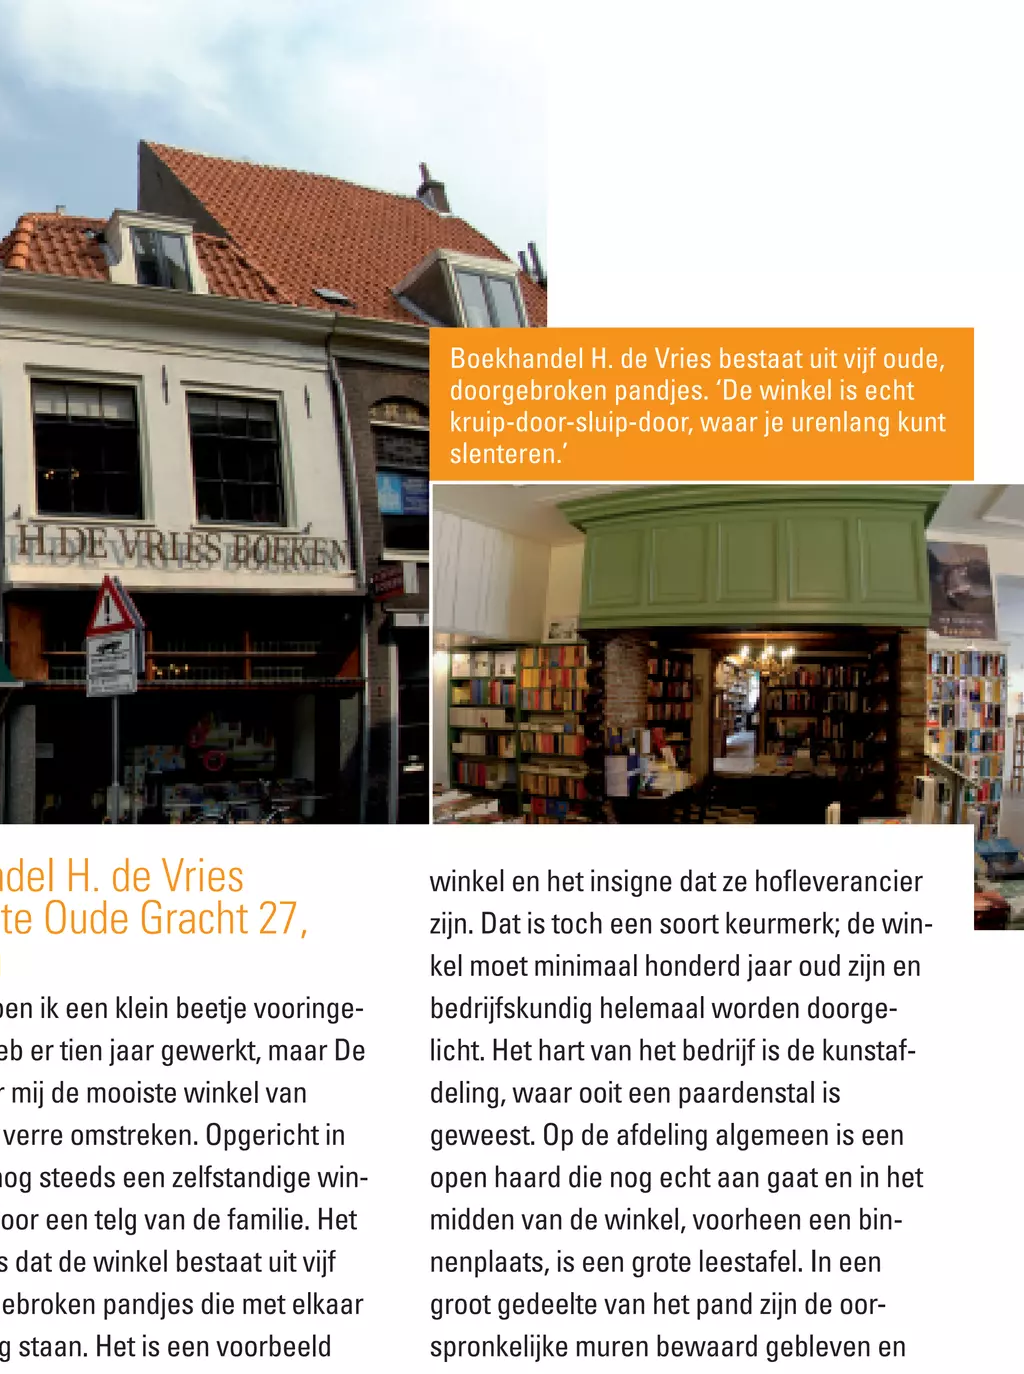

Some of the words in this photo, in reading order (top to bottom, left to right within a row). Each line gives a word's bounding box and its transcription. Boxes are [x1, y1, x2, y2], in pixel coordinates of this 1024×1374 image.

[451, 346, 583, 369] Boekhandel
[591, 347, 613, 369] H.
[621, 347, 648, 369] de
[654, 346, 712, 369] Vries
[719, 346, 804, 369] bestaat
[810, 346, 838, 369] uit
[843, 346, 877, 374] vijf
[883, 347, 945, 373] oude,
[450, 378, 607, 406] doorgebroken
[615, 378, 709, 406] pandjes.
[759, 378, 832, 401] winkel
[840, 378, 858, 401] is
[865, 378, 915, 401] echt
[450, 410, 693, 438] kruip-door-sluip-door,
[699, 415, 758, 433] waar
[763, 410, 784, 438] je
[791, 410, 890, 438] urenlang
[898, 410, 946, 433] kunt
[120, 528, 221, 563] VRIES
[233, 533, 348, 567] BOEKEN
[68, 857, 99, 893] H.
[112, 857, 151, 893] de
[161, 857, 244, 893] Vries
[45, 899, 129, 935] Oude
[141, 899, 249, 935] Gracht
[259, 900, 307, 939] 27,
[431, 995, 592, 1025] bedrijfskundig
[600, 995, 705, 1019] helemaal
[711, 995, 800, 1019] worden
[807, 995, 898, 1025] doorge-
[2, 1128, 63, 1146] verre
[70, 1122, 198, 1146] omstreken.
[206, 1122, 320, 1152] Opgericht
[326, 1122, 345, 1146] in
[103, 1291, 194, 1321] pandjes
[201, 1291, 235, 1315] die
[242, 1294, 287, 1315] met
[292, 1291, 364, 1315] elkaar
[430, 1333, 568, 1363] spronkelijke
[576, 1340, 649, 1358] muren
[657, 1333, 758, 1358] bewaard
[766, 1333, 870, 1363] gebleven
[878, 1340, 906, 1358] en
